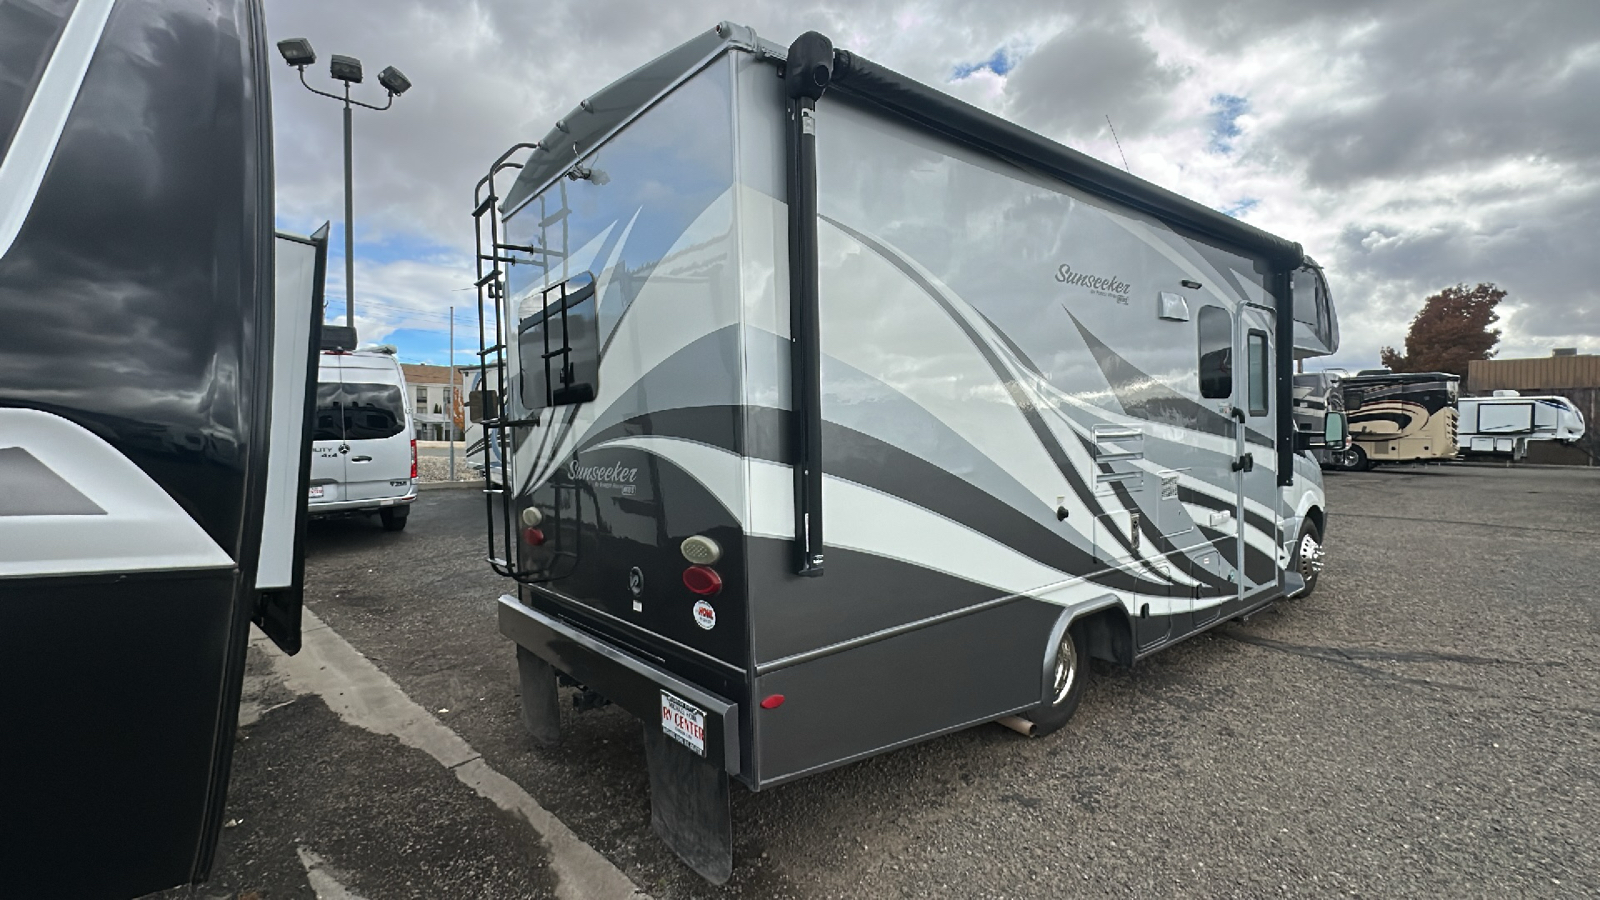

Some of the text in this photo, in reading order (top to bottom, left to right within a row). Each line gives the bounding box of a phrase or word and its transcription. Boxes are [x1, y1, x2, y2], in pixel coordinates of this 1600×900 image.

[1054, 264, 1130, 294] Sunseeker
[567, 460, 638, 482] Sunseeker
[662, 706, 673, 721] RV
[674, 712, 705, 741] CENTER
